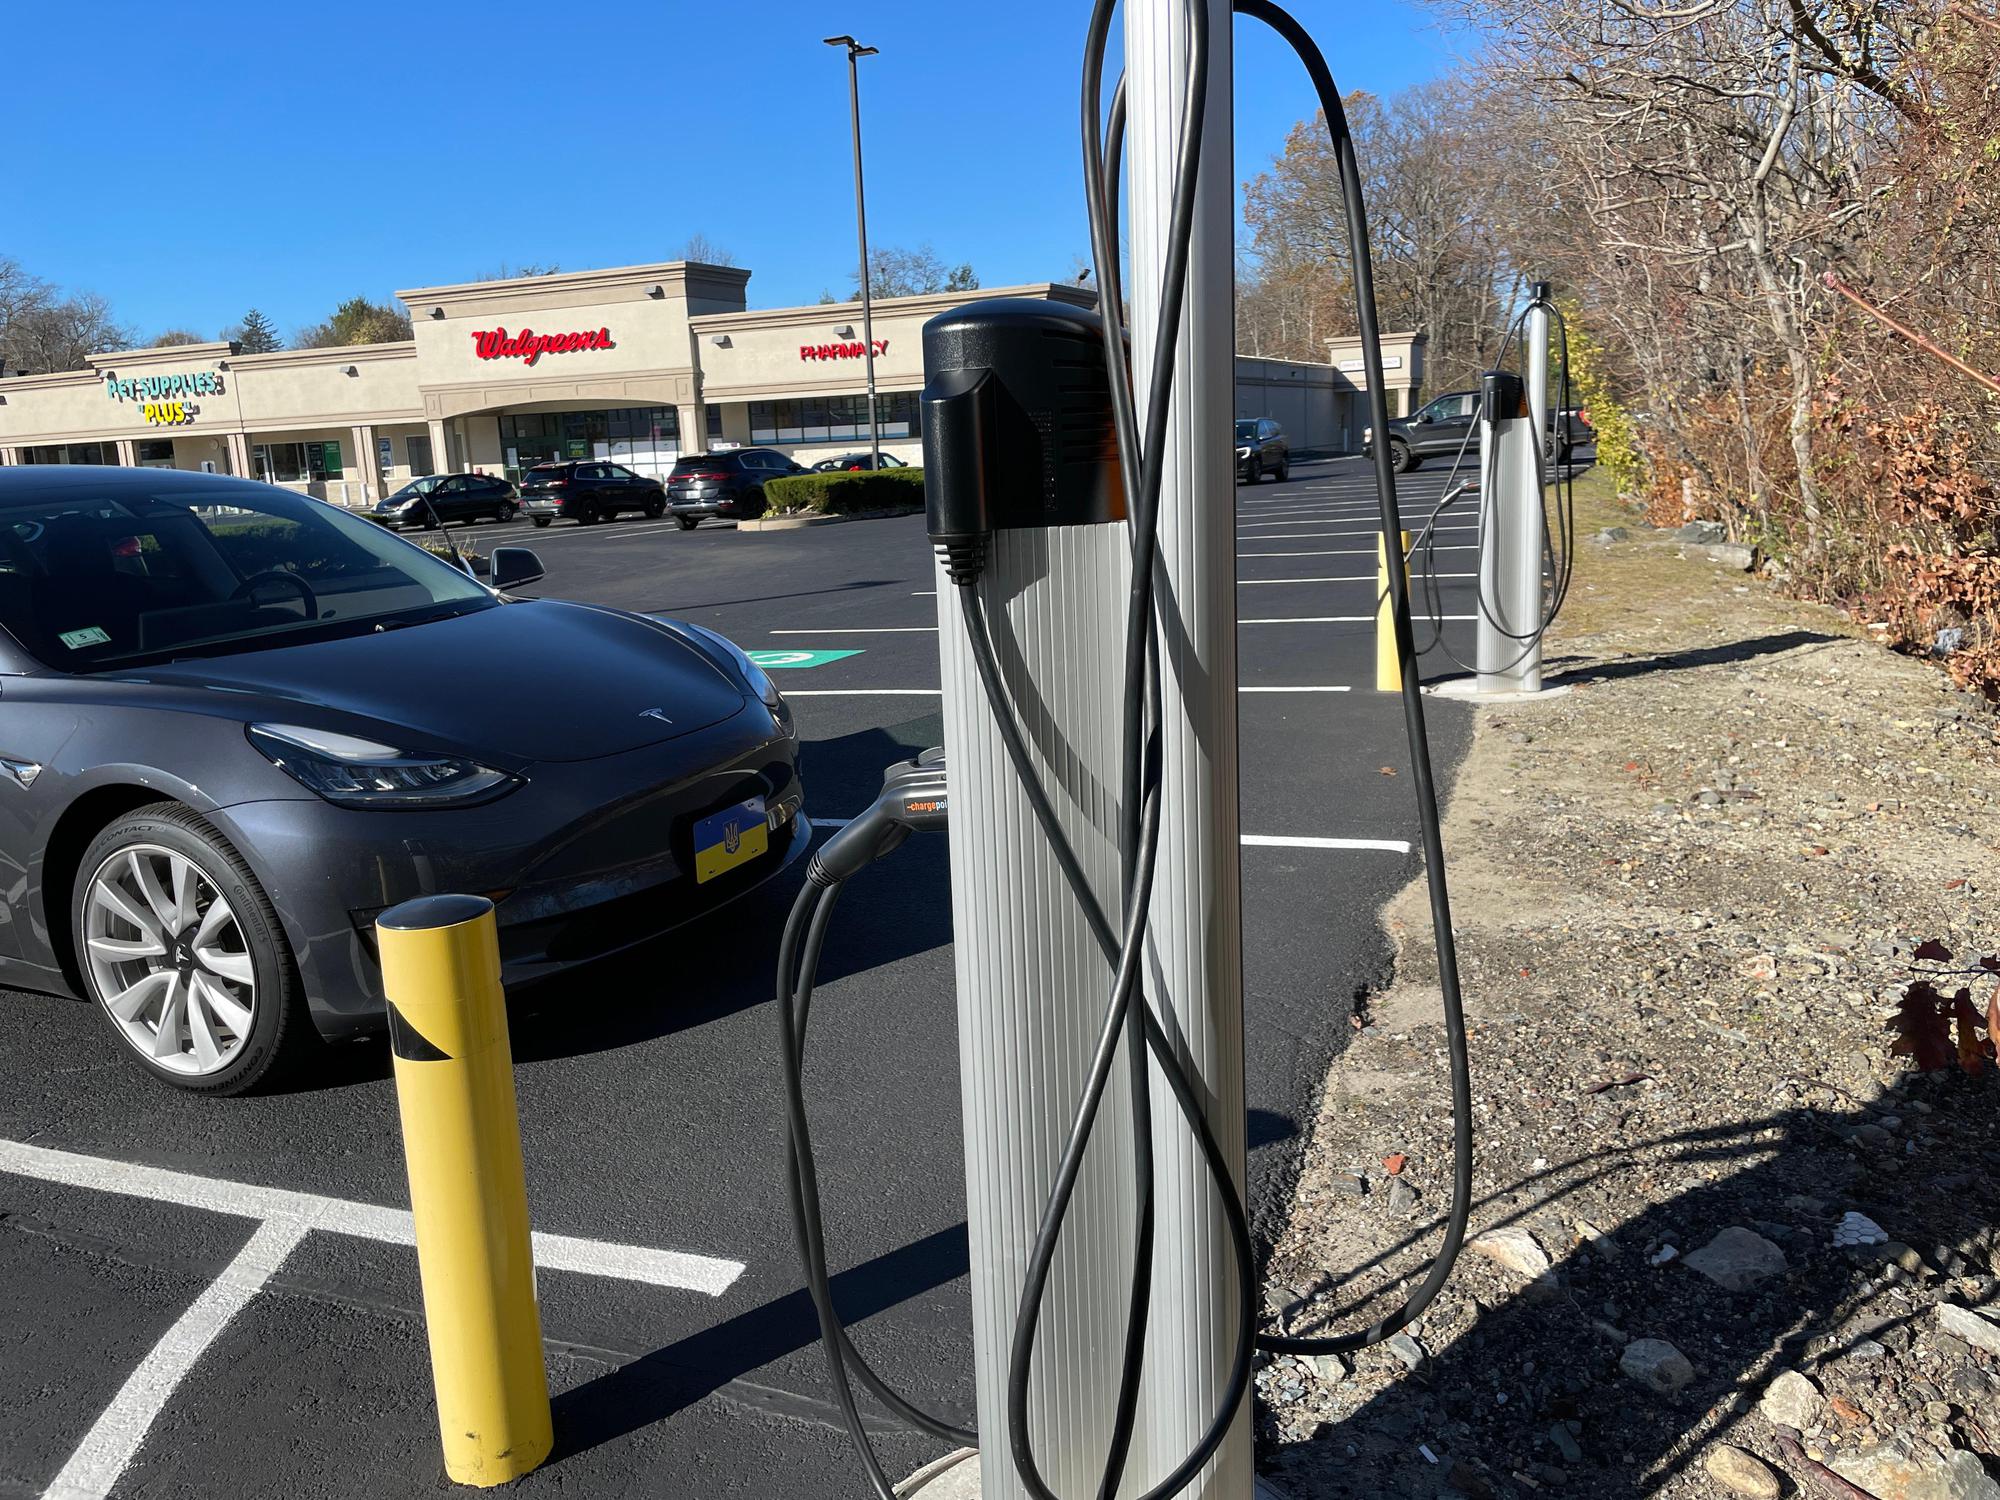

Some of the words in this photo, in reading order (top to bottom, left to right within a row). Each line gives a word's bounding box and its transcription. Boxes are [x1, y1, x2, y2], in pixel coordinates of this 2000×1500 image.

[471, 327, 613, 365] Walgreens
[107, 378, 137, 399] PET
[140, 372, 217, 397] SUPPLIES
[911, 800, 947, 812] chargepoi
